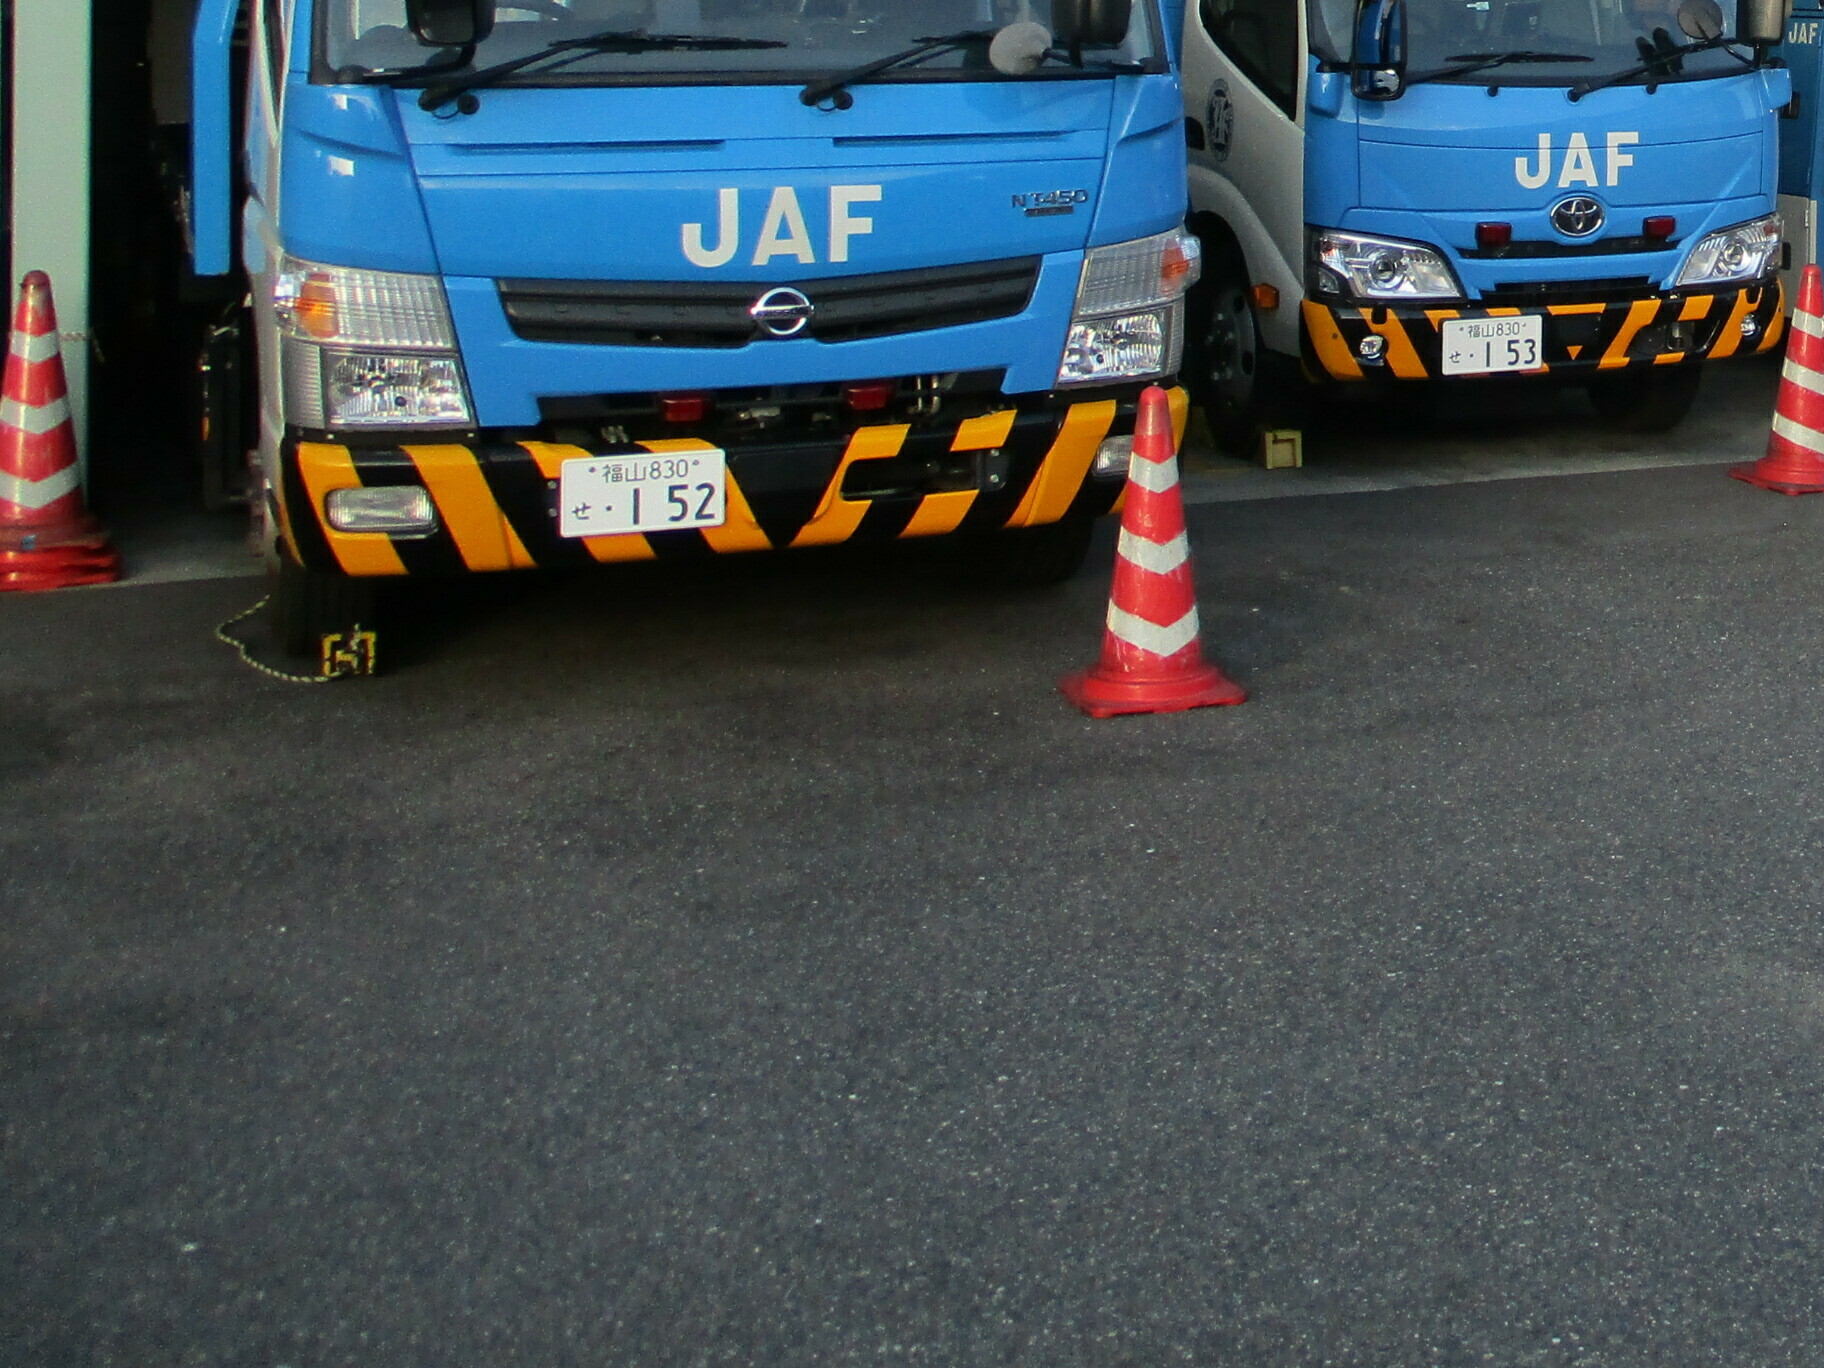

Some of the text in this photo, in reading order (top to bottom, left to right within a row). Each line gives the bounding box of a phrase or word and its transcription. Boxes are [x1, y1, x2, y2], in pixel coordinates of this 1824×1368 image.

[1788, 23, 1819, 44] JAF
[1514, 131, 1640, 189] JAF
[1011, 189, 1089, 207] NT450
[681, 184, 882, 268] JAF
